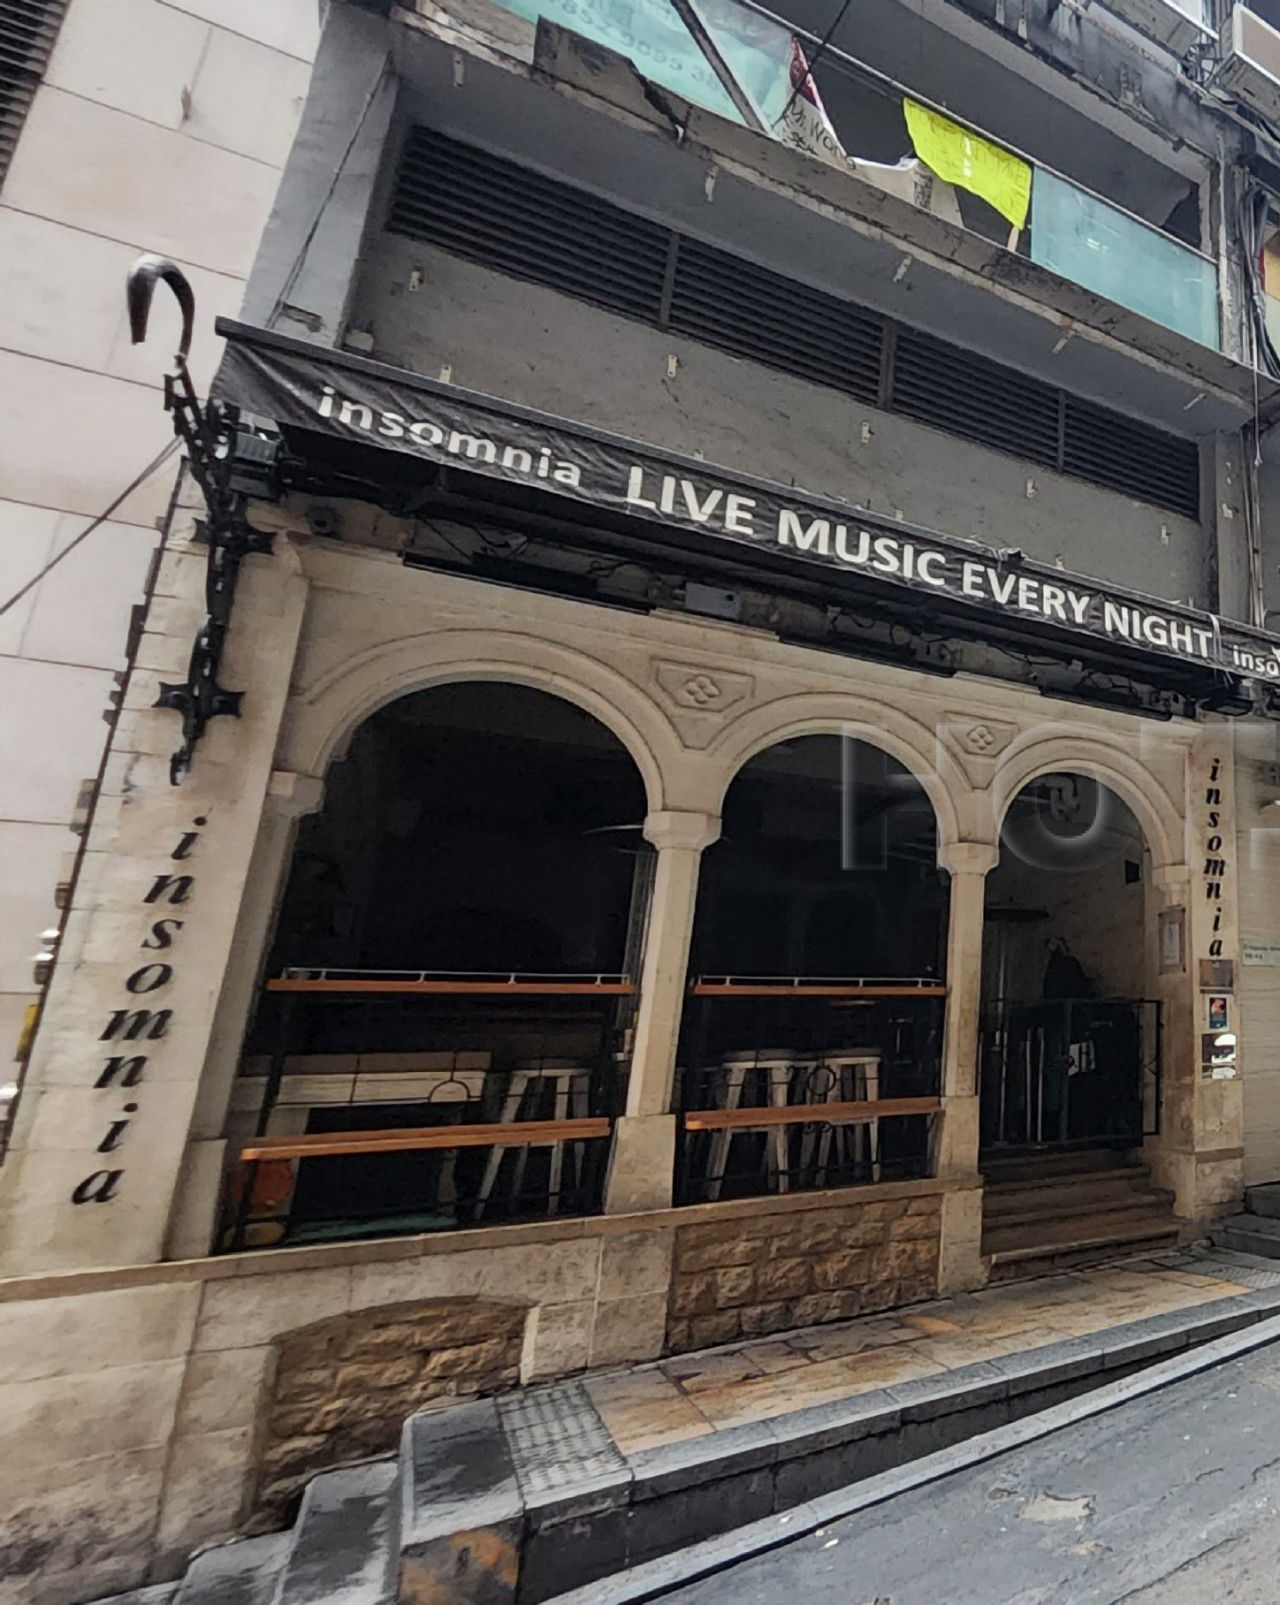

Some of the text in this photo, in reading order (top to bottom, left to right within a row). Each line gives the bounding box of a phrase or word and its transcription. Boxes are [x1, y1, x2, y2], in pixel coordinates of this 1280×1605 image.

[318, 386, 582, 487] insomnia
[626, 465, 757, 536] LIVE
[777, 509, 946, 587] MUSIC
[962, 561, 1090, 625] EVERY
[1104, 601, 1213, 659] NIGHT
[1204, 758, 1226, 957] insomnia
[71, 816, 207, 1204] insomnia
